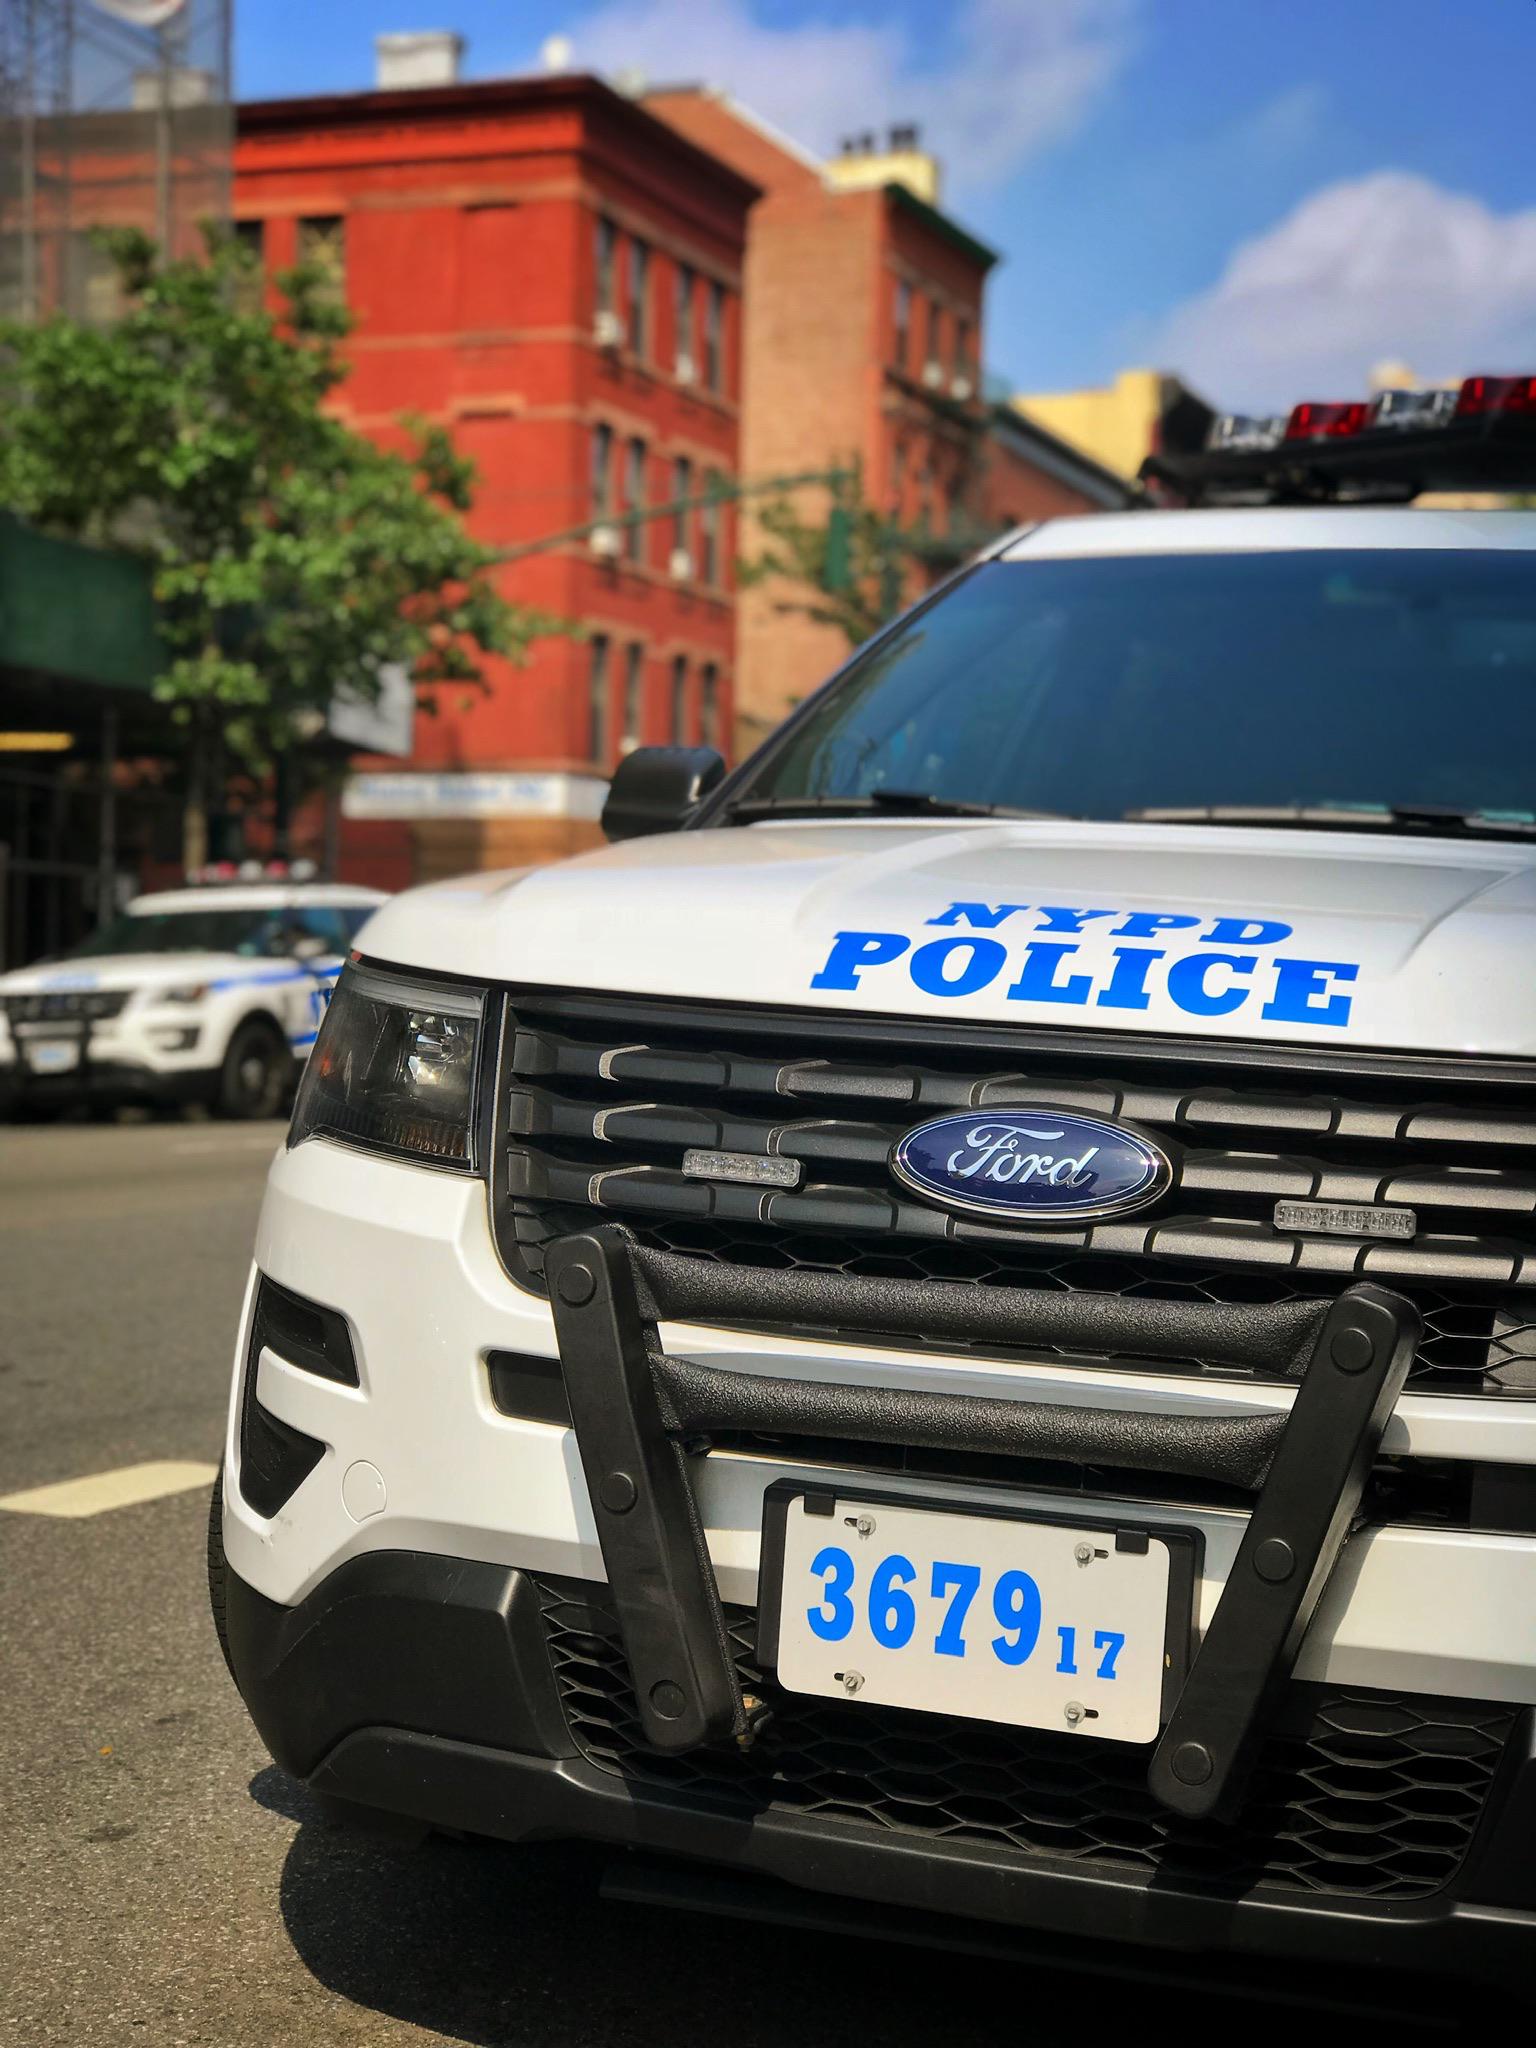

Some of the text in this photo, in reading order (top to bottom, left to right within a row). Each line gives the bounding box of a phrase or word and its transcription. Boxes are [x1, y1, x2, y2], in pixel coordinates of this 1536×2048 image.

[926, 902, 1293, 945] NYPD
[810, 931, 1360, 1027] POLICE
[947, 1123, 1100, 1188] Ford
[806, 1546, 1126, 1680] 3679 17
